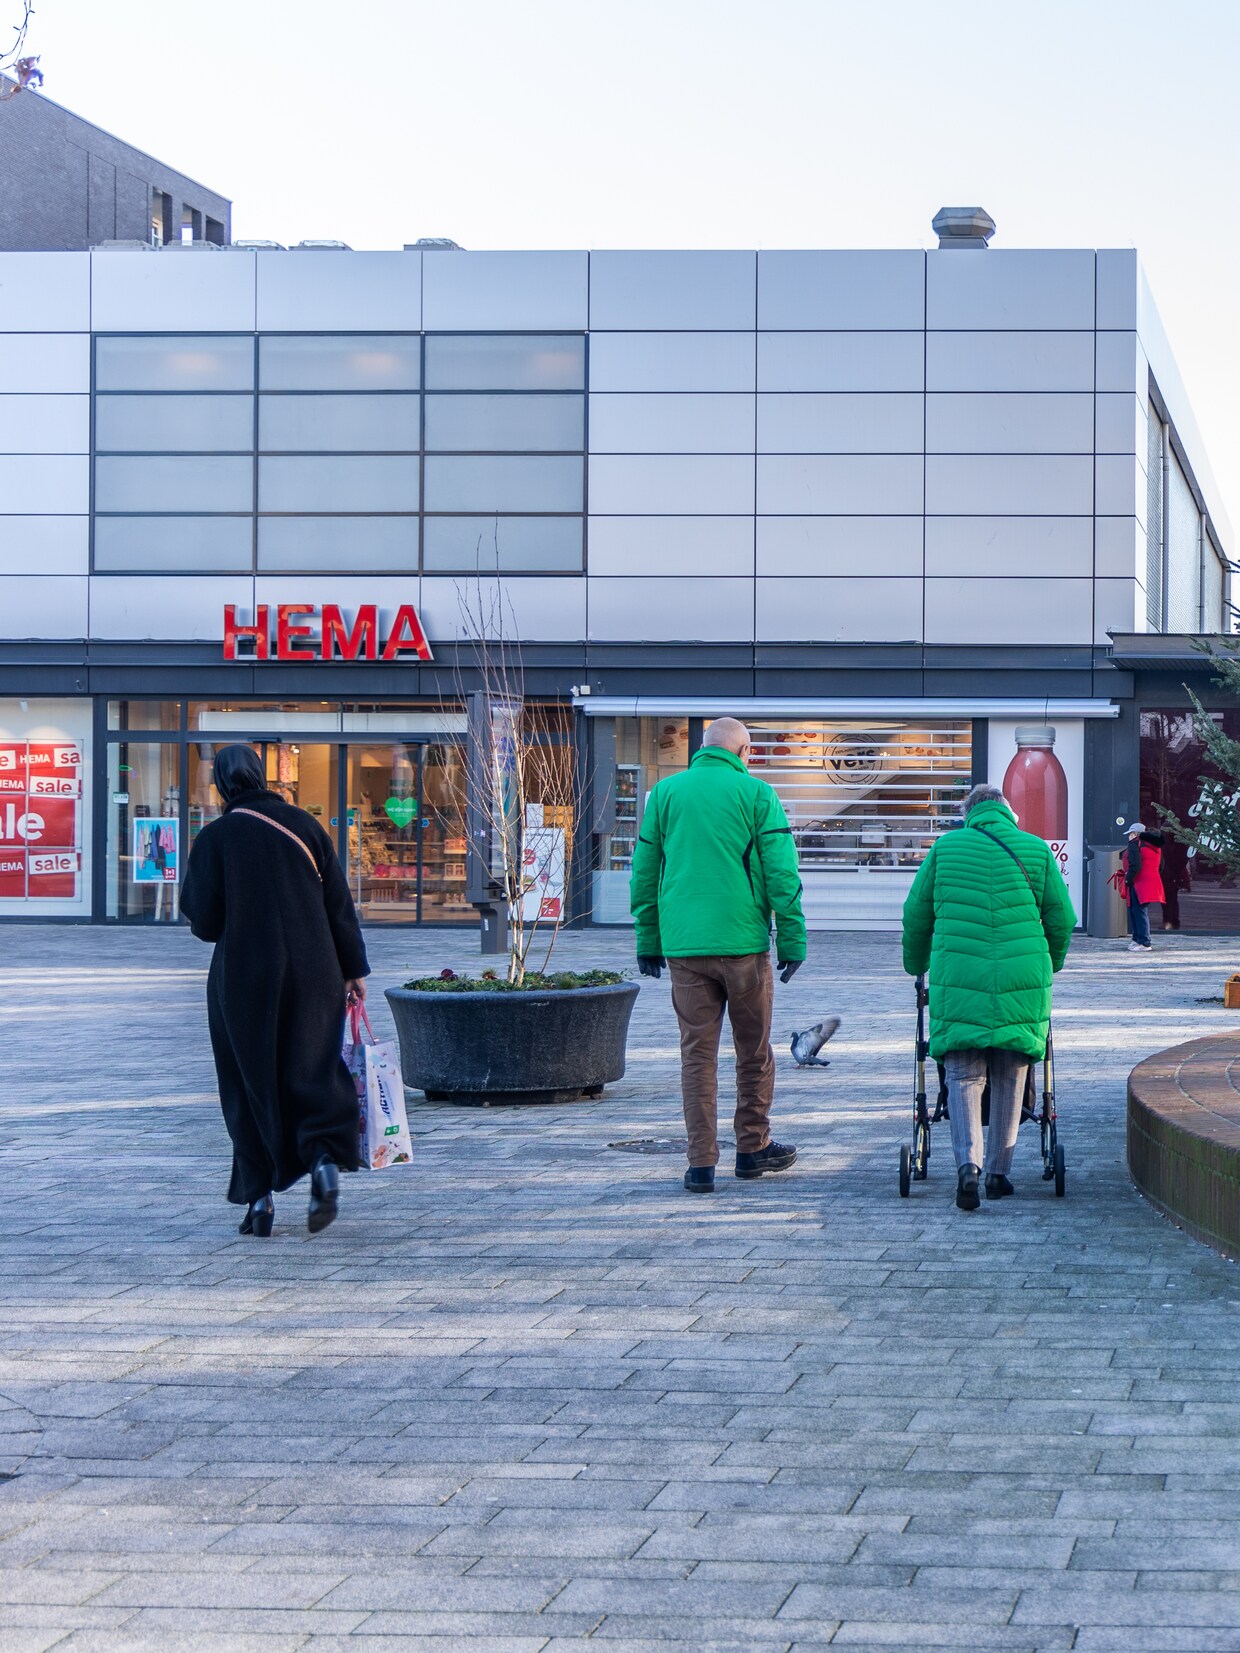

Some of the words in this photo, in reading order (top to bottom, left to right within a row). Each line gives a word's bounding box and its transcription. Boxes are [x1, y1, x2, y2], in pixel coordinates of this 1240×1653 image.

[224, 604, 434, 661] HEMA
[20, 754, 50, 764] HEMA
[0, 780, 24, 789] EMA
[36, 779, 72, 796] sale
[0, 803, 45, 841] le
[0, 862, 24, 871] EMA
[35, 855, 71, 871] sale
